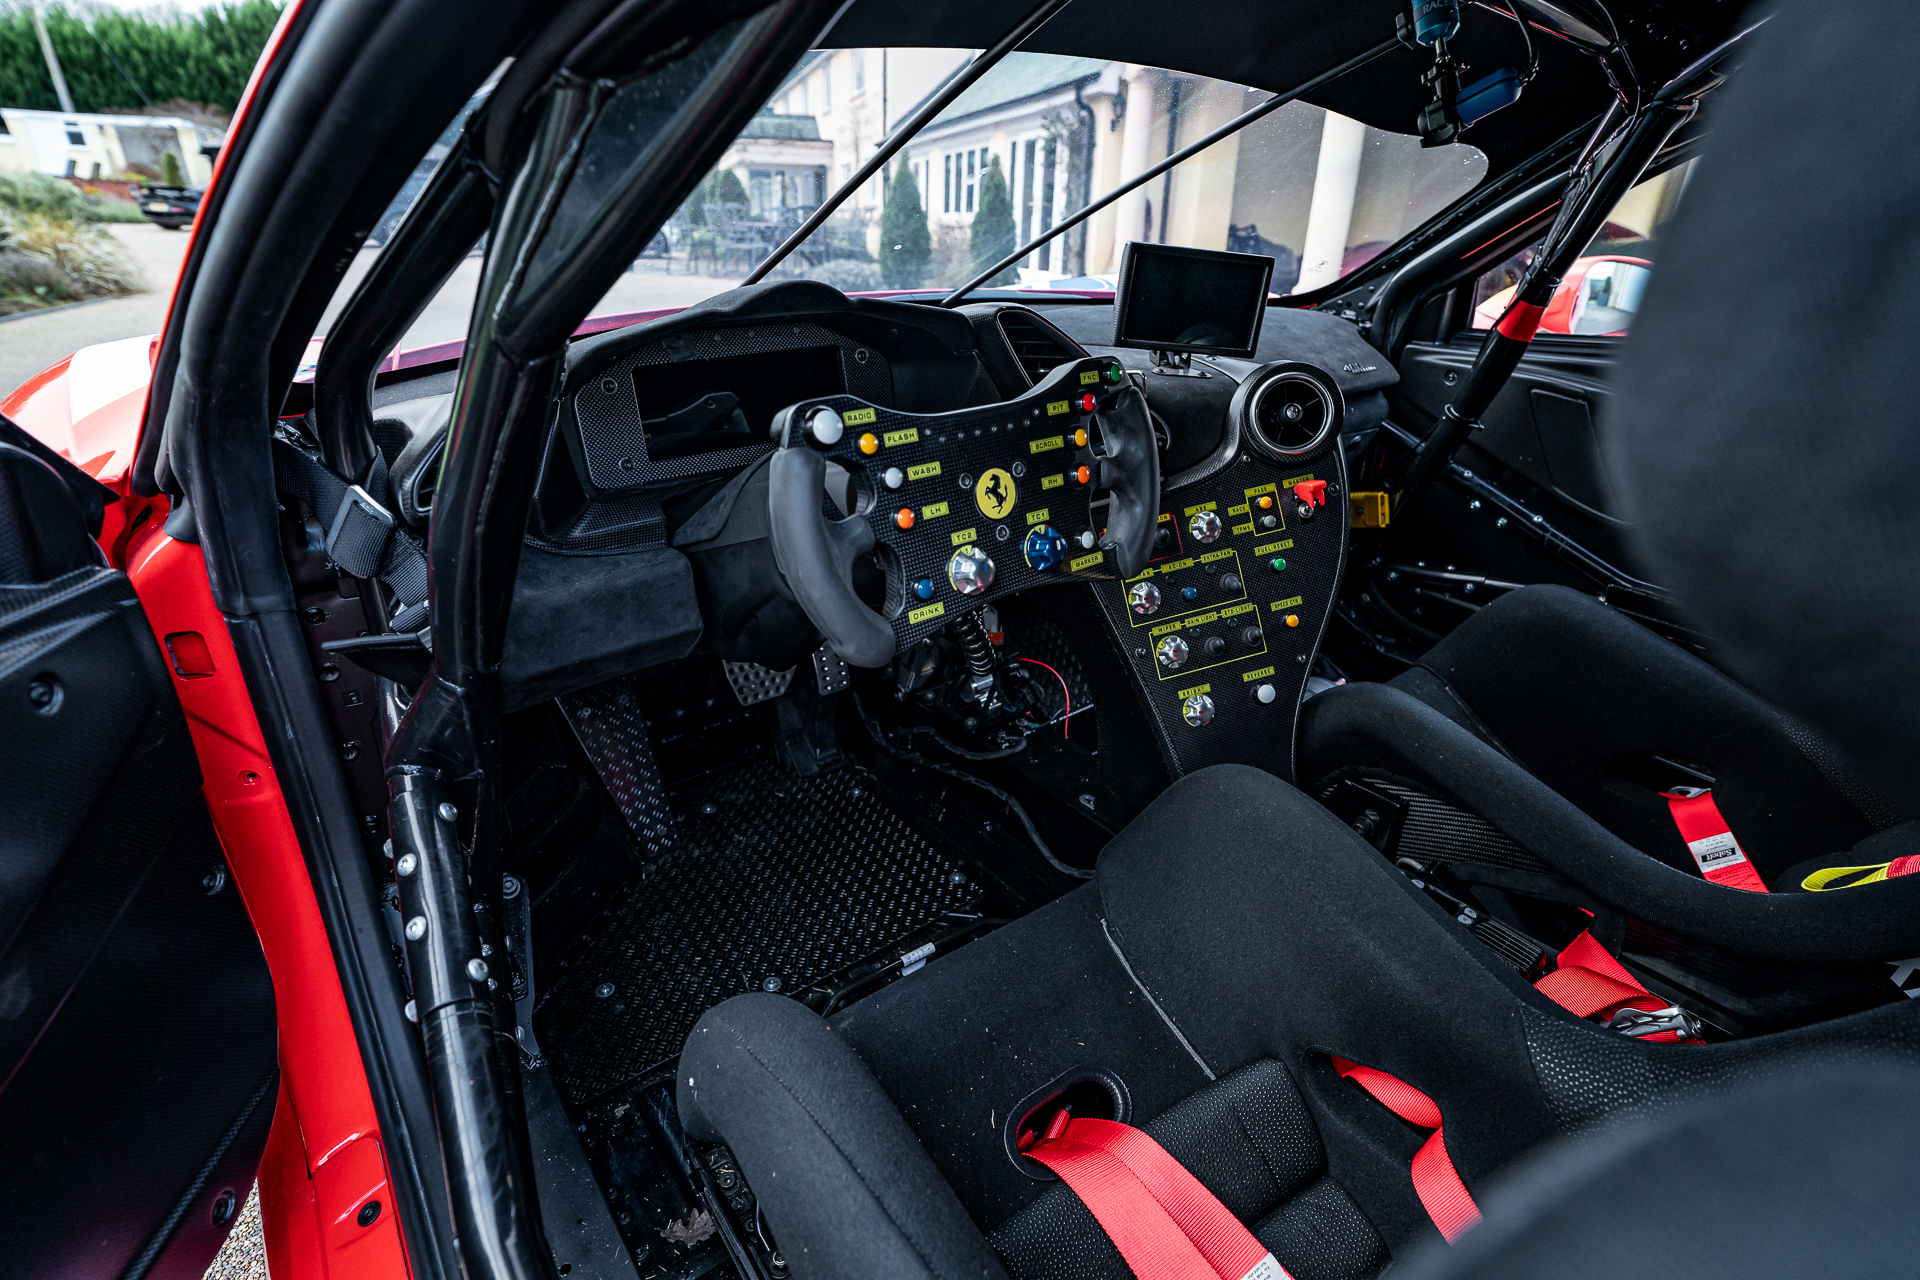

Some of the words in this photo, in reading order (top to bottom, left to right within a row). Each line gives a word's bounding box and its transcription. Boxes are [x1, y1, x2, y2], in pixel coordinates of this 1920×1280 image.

[1083, 374, 1097, 382] FNC
[1052, 404, 1064, 412] PIT
[846, 411, 873, 423] RADIO
[887, 432, 916, 443] FLASH
[1035, 439, 1059, 450] SCROLL
[911, 465, 938, 477] WASH
[1047, 478, 1058, 486] RH
[930, 506, 942, 515] LH
[1195, 504, 1207, 512] ABS
[1030, 512, 1046, 521] TC1
[956, 532, 973, 542] TC2
[1257, 541, 1291, 554] FUEL-RESET
[1075, 555, 1100, 568] MARKER
[913, 605, 941, 620] DRINK
[1157, 623, 1176, 633] WIPER
[1706, 849, 1732, 861] Sabelt
